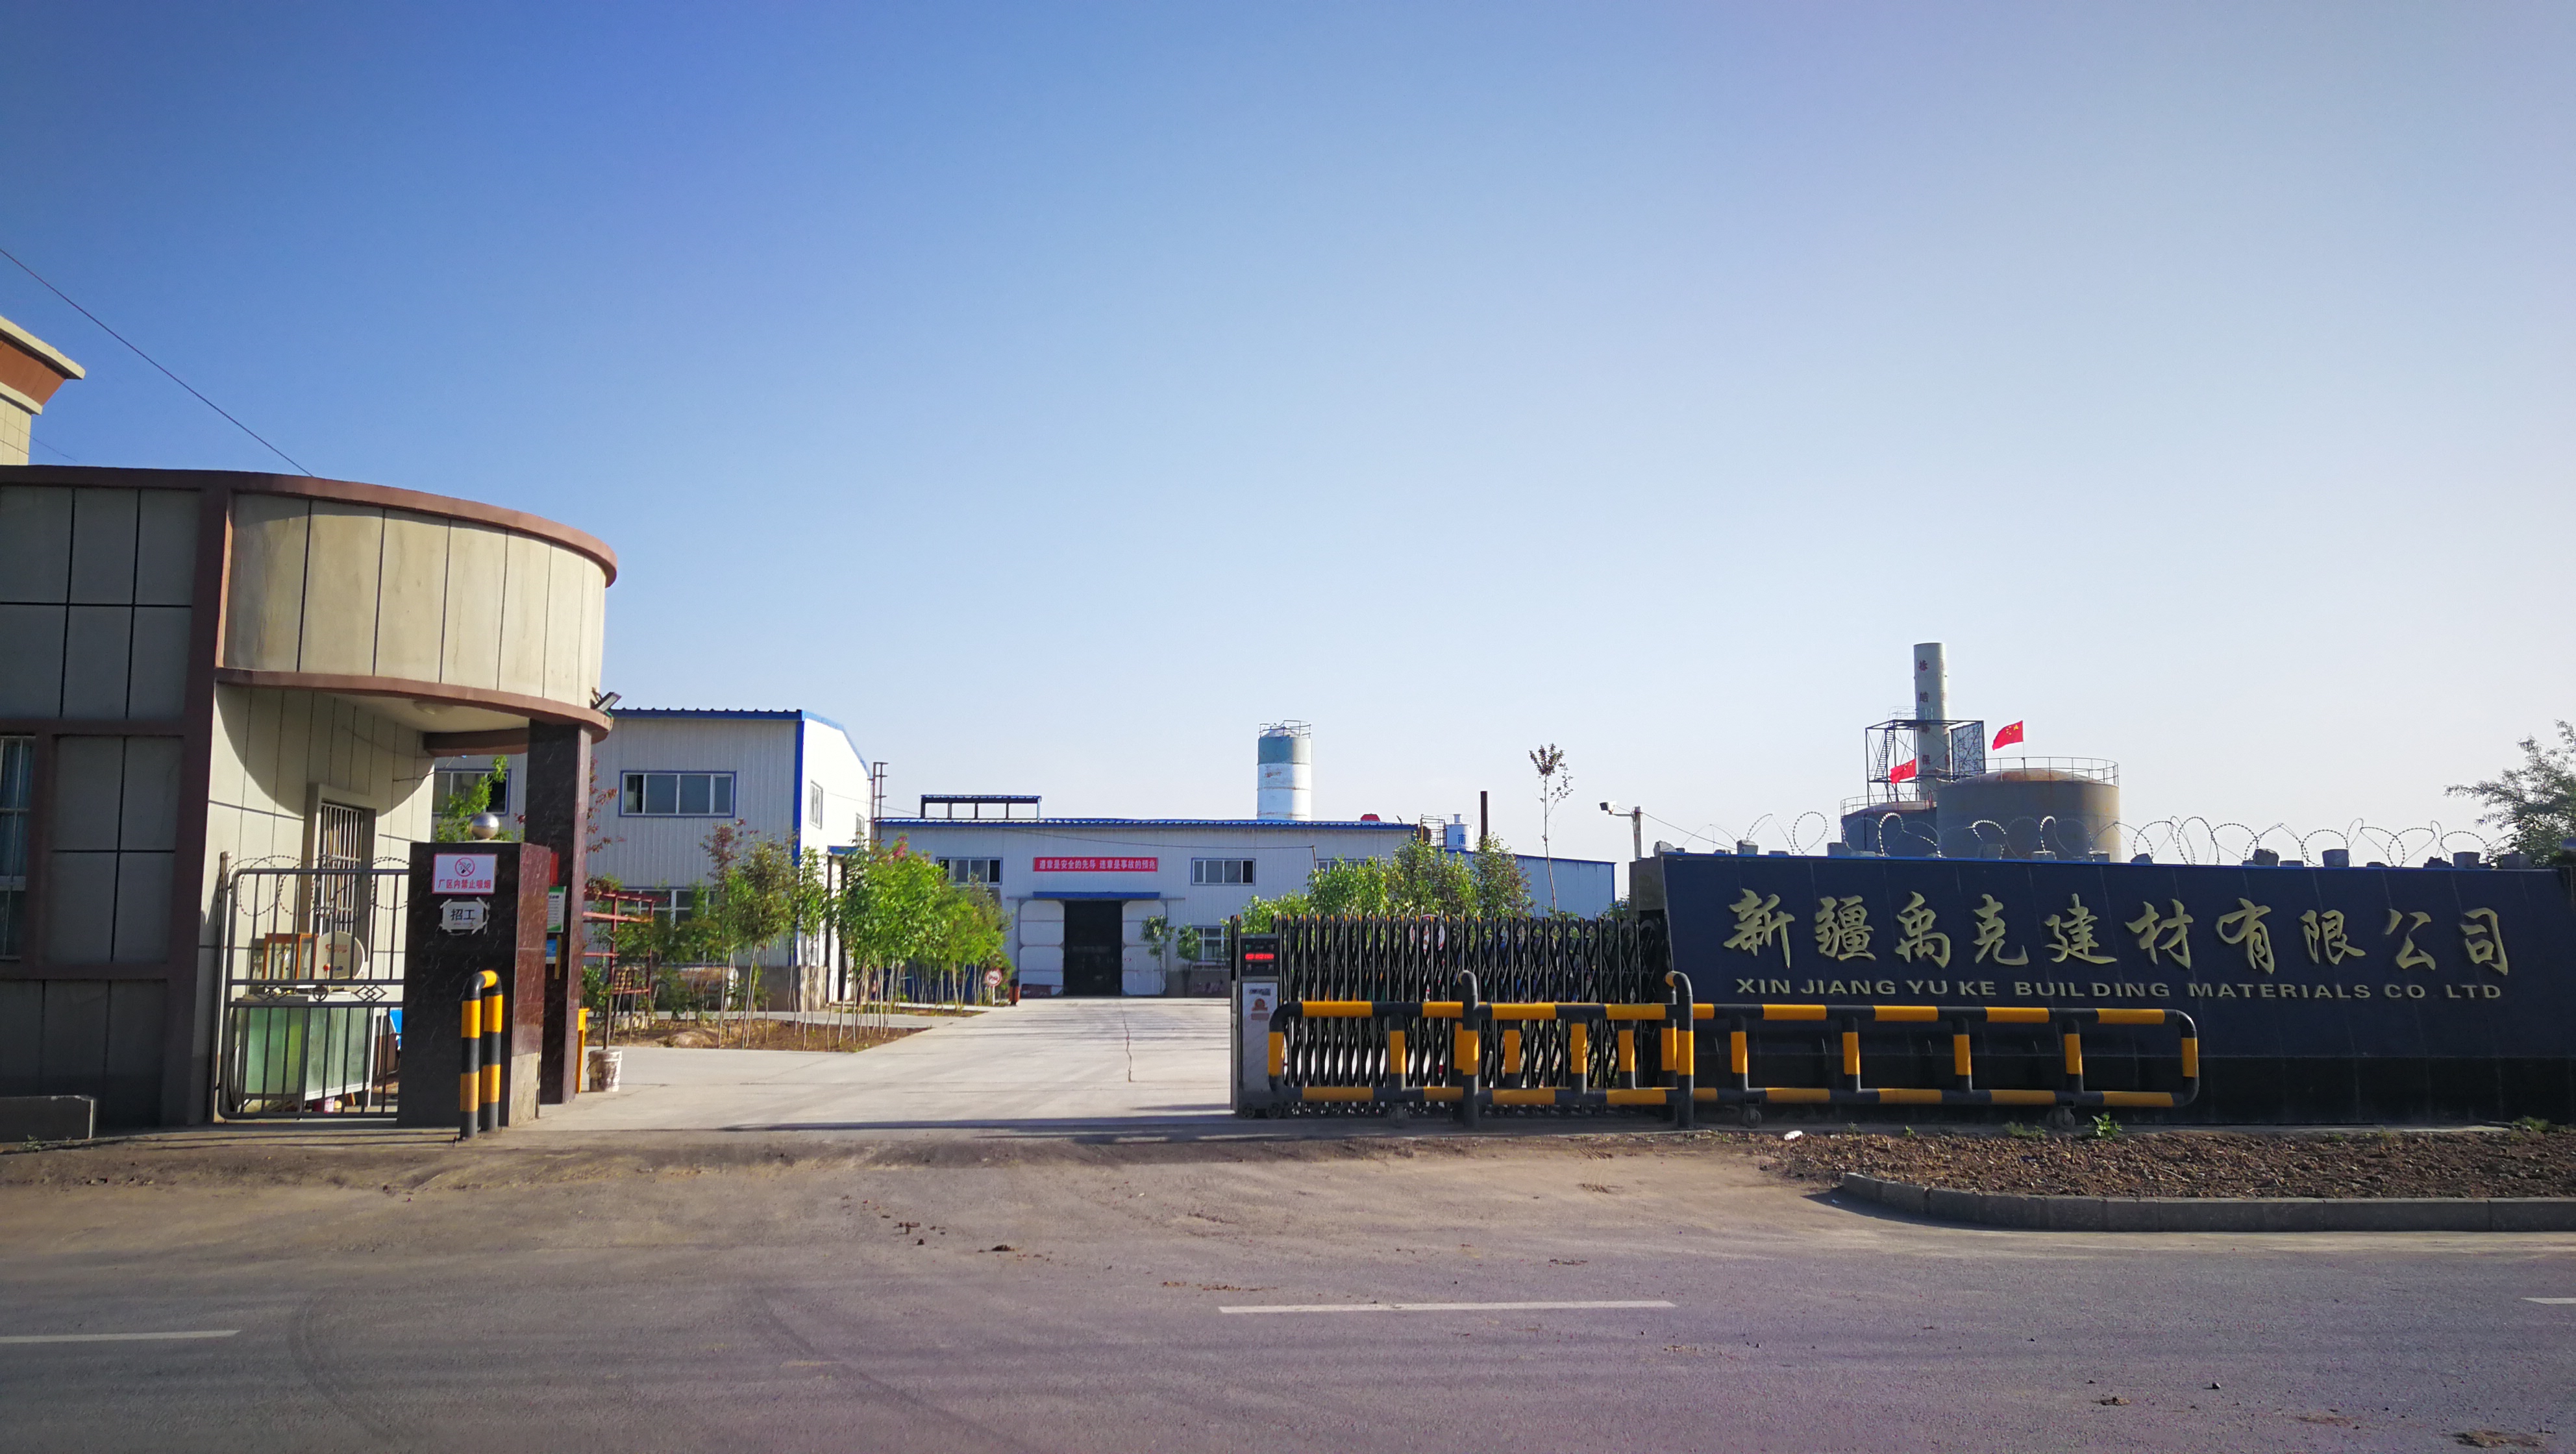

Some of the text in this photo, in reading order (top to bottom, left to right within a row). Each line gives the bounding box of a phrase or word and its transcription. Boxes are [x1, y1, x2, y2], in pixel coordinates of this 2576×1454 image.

[438, 879, 491, 889] 厂区内禁止吸烟
[450, 909, 476, 921] 招工
[1724, 889, 2508, 976] 新疆禹克建材有限公司
[1737, 979, 2501, 1000] XIN JIANG YU KE BUILDING MATERIALS CO LTD
